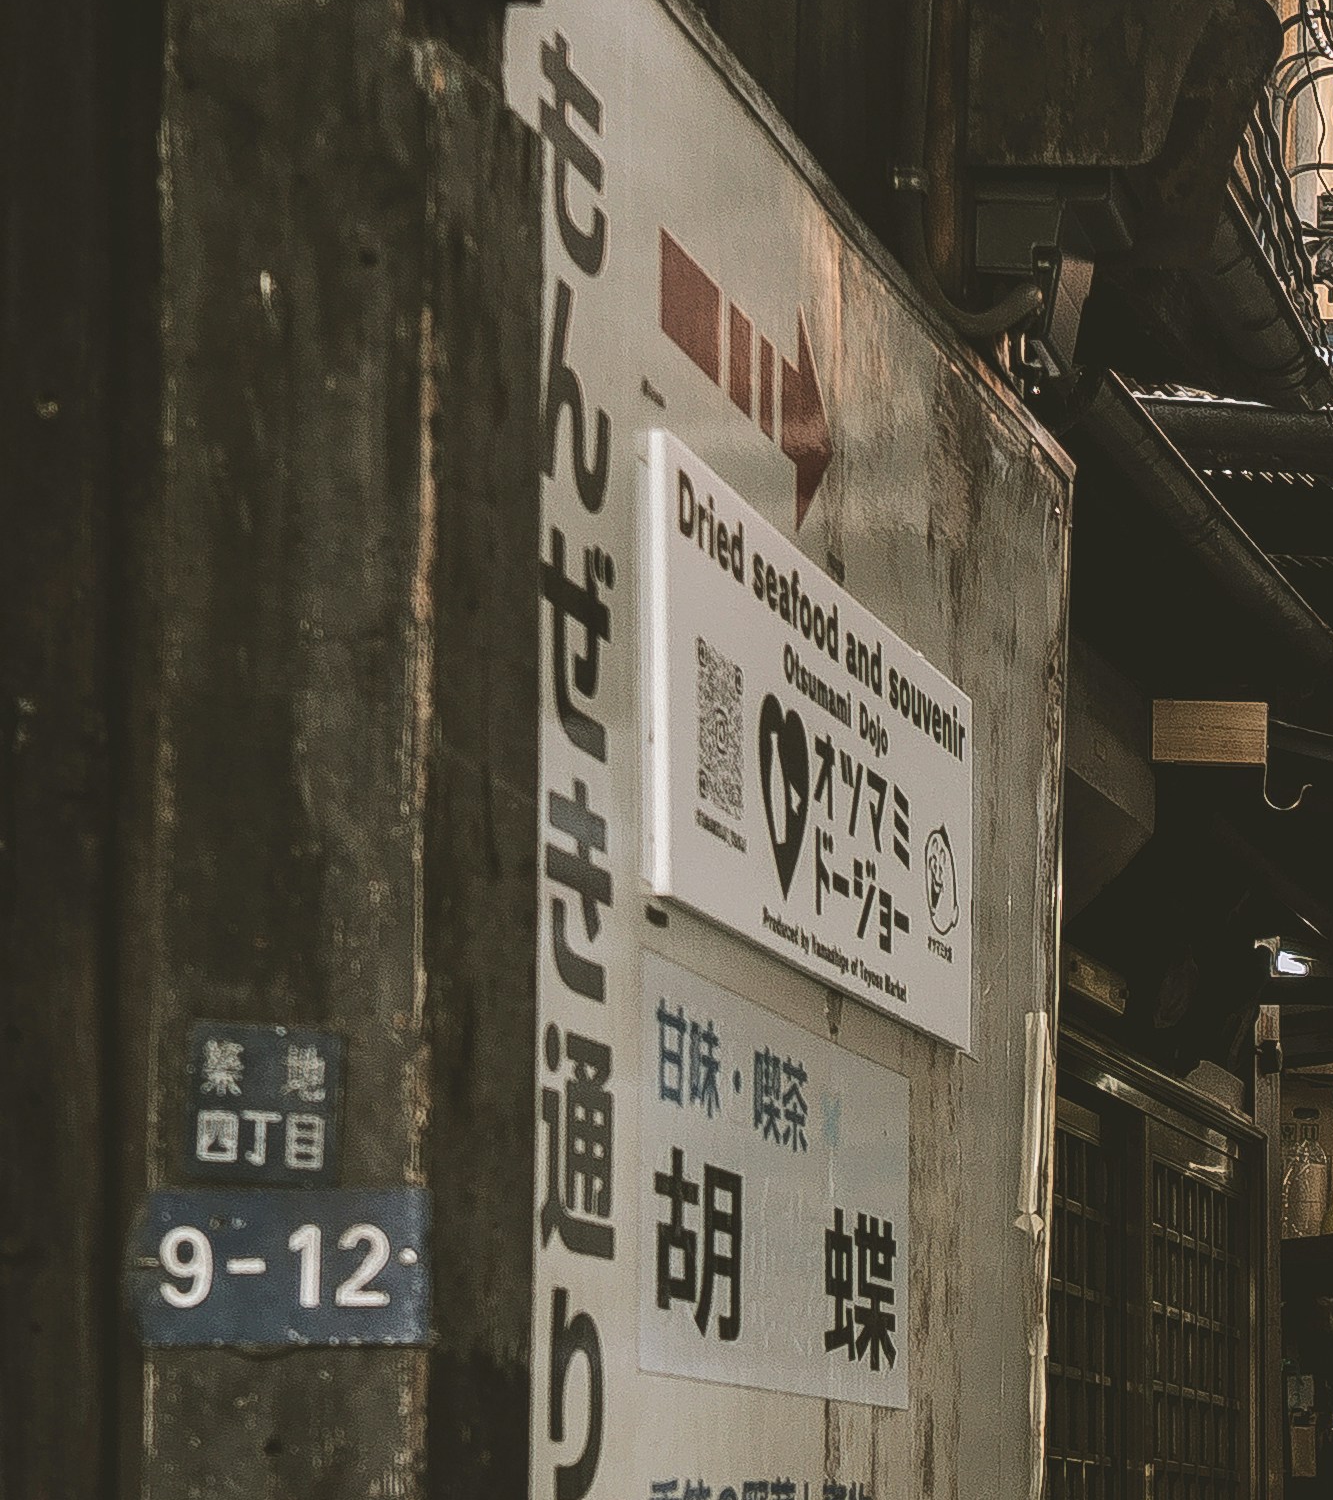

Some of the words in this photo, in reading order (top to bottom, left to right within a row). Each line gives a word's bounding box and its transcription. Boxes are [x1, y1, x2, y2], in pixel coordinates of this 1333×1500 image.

[678, 468, 745, 586] Dried
[753, 552, 839, 663] seafood
[846, 630, 882, 698] and
[889, 666, 966, 762] souvenir
[784, 643, 852, 728] Otsumami
[859, 700, 888, 758] Dojo
[814, 733, 910, 871] オツマミ
[815, 826, 910, 954] ドージョー
[196, 1109, 326, 1171] 四丁目
[655, 1003, 809, 1153] 甘味・喫茶
[158, 1224, 391, 1310] 9-12
